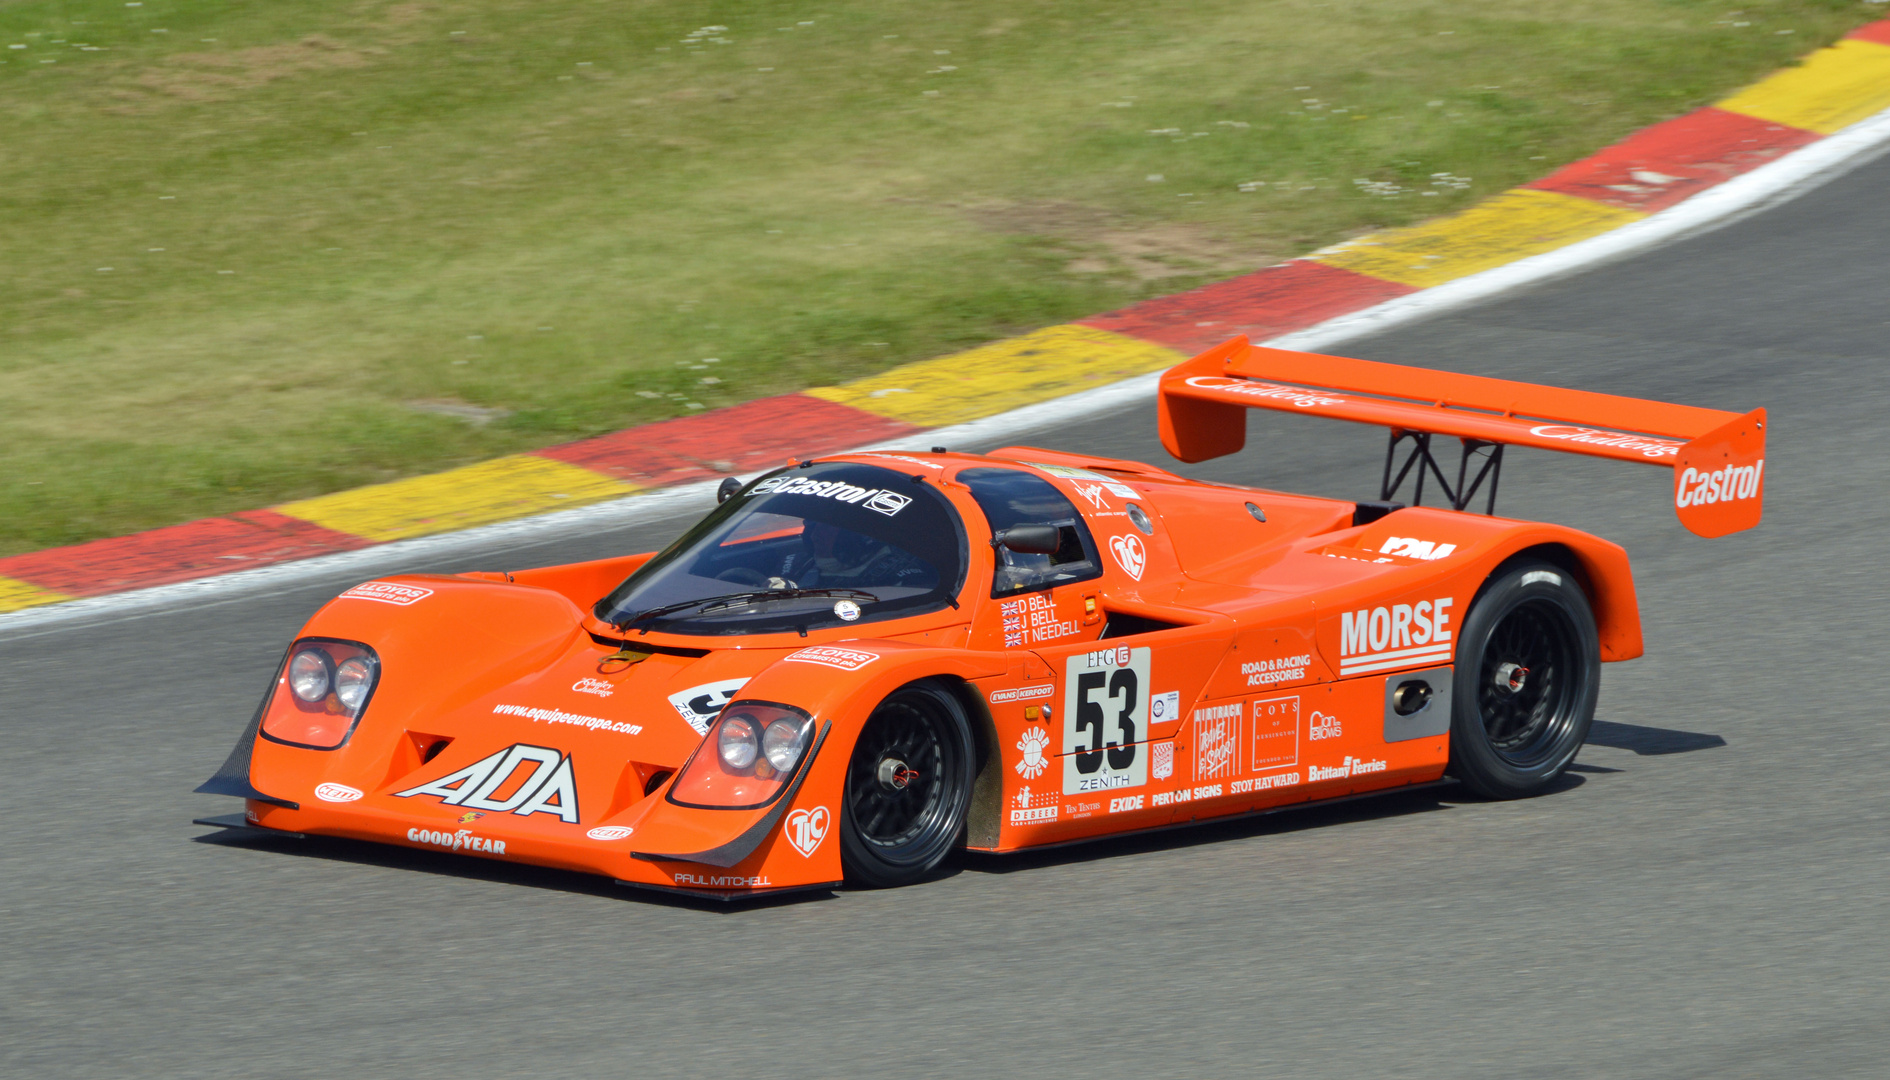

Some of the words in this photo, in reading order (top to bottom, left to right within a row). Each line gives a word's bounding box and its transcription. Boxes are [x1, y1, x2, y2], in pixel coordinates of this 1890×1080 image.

[1185, 376, 1345, 406] Challenge
[1530, 425, 1679, 457] Challeng
[772, 477, 879, 504] Castrol
[1070, 479, 1110, 509] Virgin
[1676, 459, 1764, 508] Castrol
[1114, 537, 1143, 576] TLC
[347, 589, 396, 600] CHEMISTS
[356, 583, 424, 598] LLOYDS
[1018, 600, 1027, 613] D
[1029, 593, 1057, 611] BELL
[1021, 615, 1027, 629] J
[1031, 609, 1058, 627] BELL
[1340, 597, 1453, 656] MORSE
[1022, 630, 1029, 644] T
[1033, 620, 1081, 642] NEEDELL
[793, 653, 841, 664] CHEMISTS
[802, 648, 870, 662] LLOYDS
[1088, 649, 1114, 668] EFG
[1241, 661, 1268, 675] ROAD
[1268, 659, 1276, 671] &
[1276, 654, 1311, 670] RACING
[572, 680, 614, 698] Challenge
[1247, 668, 1305, 687] ACCESSORIES
[992, 691, 1016, 701] EVANS
[1019, 687, 1052, 698] KERFOOT
[493, 704, 643, 735] www.equipeeurope.com
[1075, 668, 1138, 774] 53
[1194, 703, 1242, 722] AIRTRACK
[1255, 702, 1298, 717] COYS
[1016, 726, 1050, 751] COLOUR
[1200, 720, 1226, 752] TRAVEL
[1256, 730, 1295, 740] KENSINGTON
[1206, 736, 1236, 770] SPORT
[1015, 757, 1049, 780] MATCH
[1308, 765, 1350, 782] Brittany
[1352, 759, 1387, 775] Ferries
[387, 742, 580, 824] ADA
[1080, 775, 1130, 790] ZENITH
[1230, 779, 1254, 795] STOY
[1254, 772, 1300, 790] HAYWARD
[1109, 795, 1145, 814] EXIDE
[1152, 789, 1191, 807] PERTON
[1193, 784, 1222, 800] SIGNS
[1014, 808, 1056, 820] DEBEER
[407, 828, 506, 854] GOODYEAR
[792, 810, 824, 853] TLC
[674, 873, 708, 886] PAUL
[711, 875, 771, 886] MITCHELL
